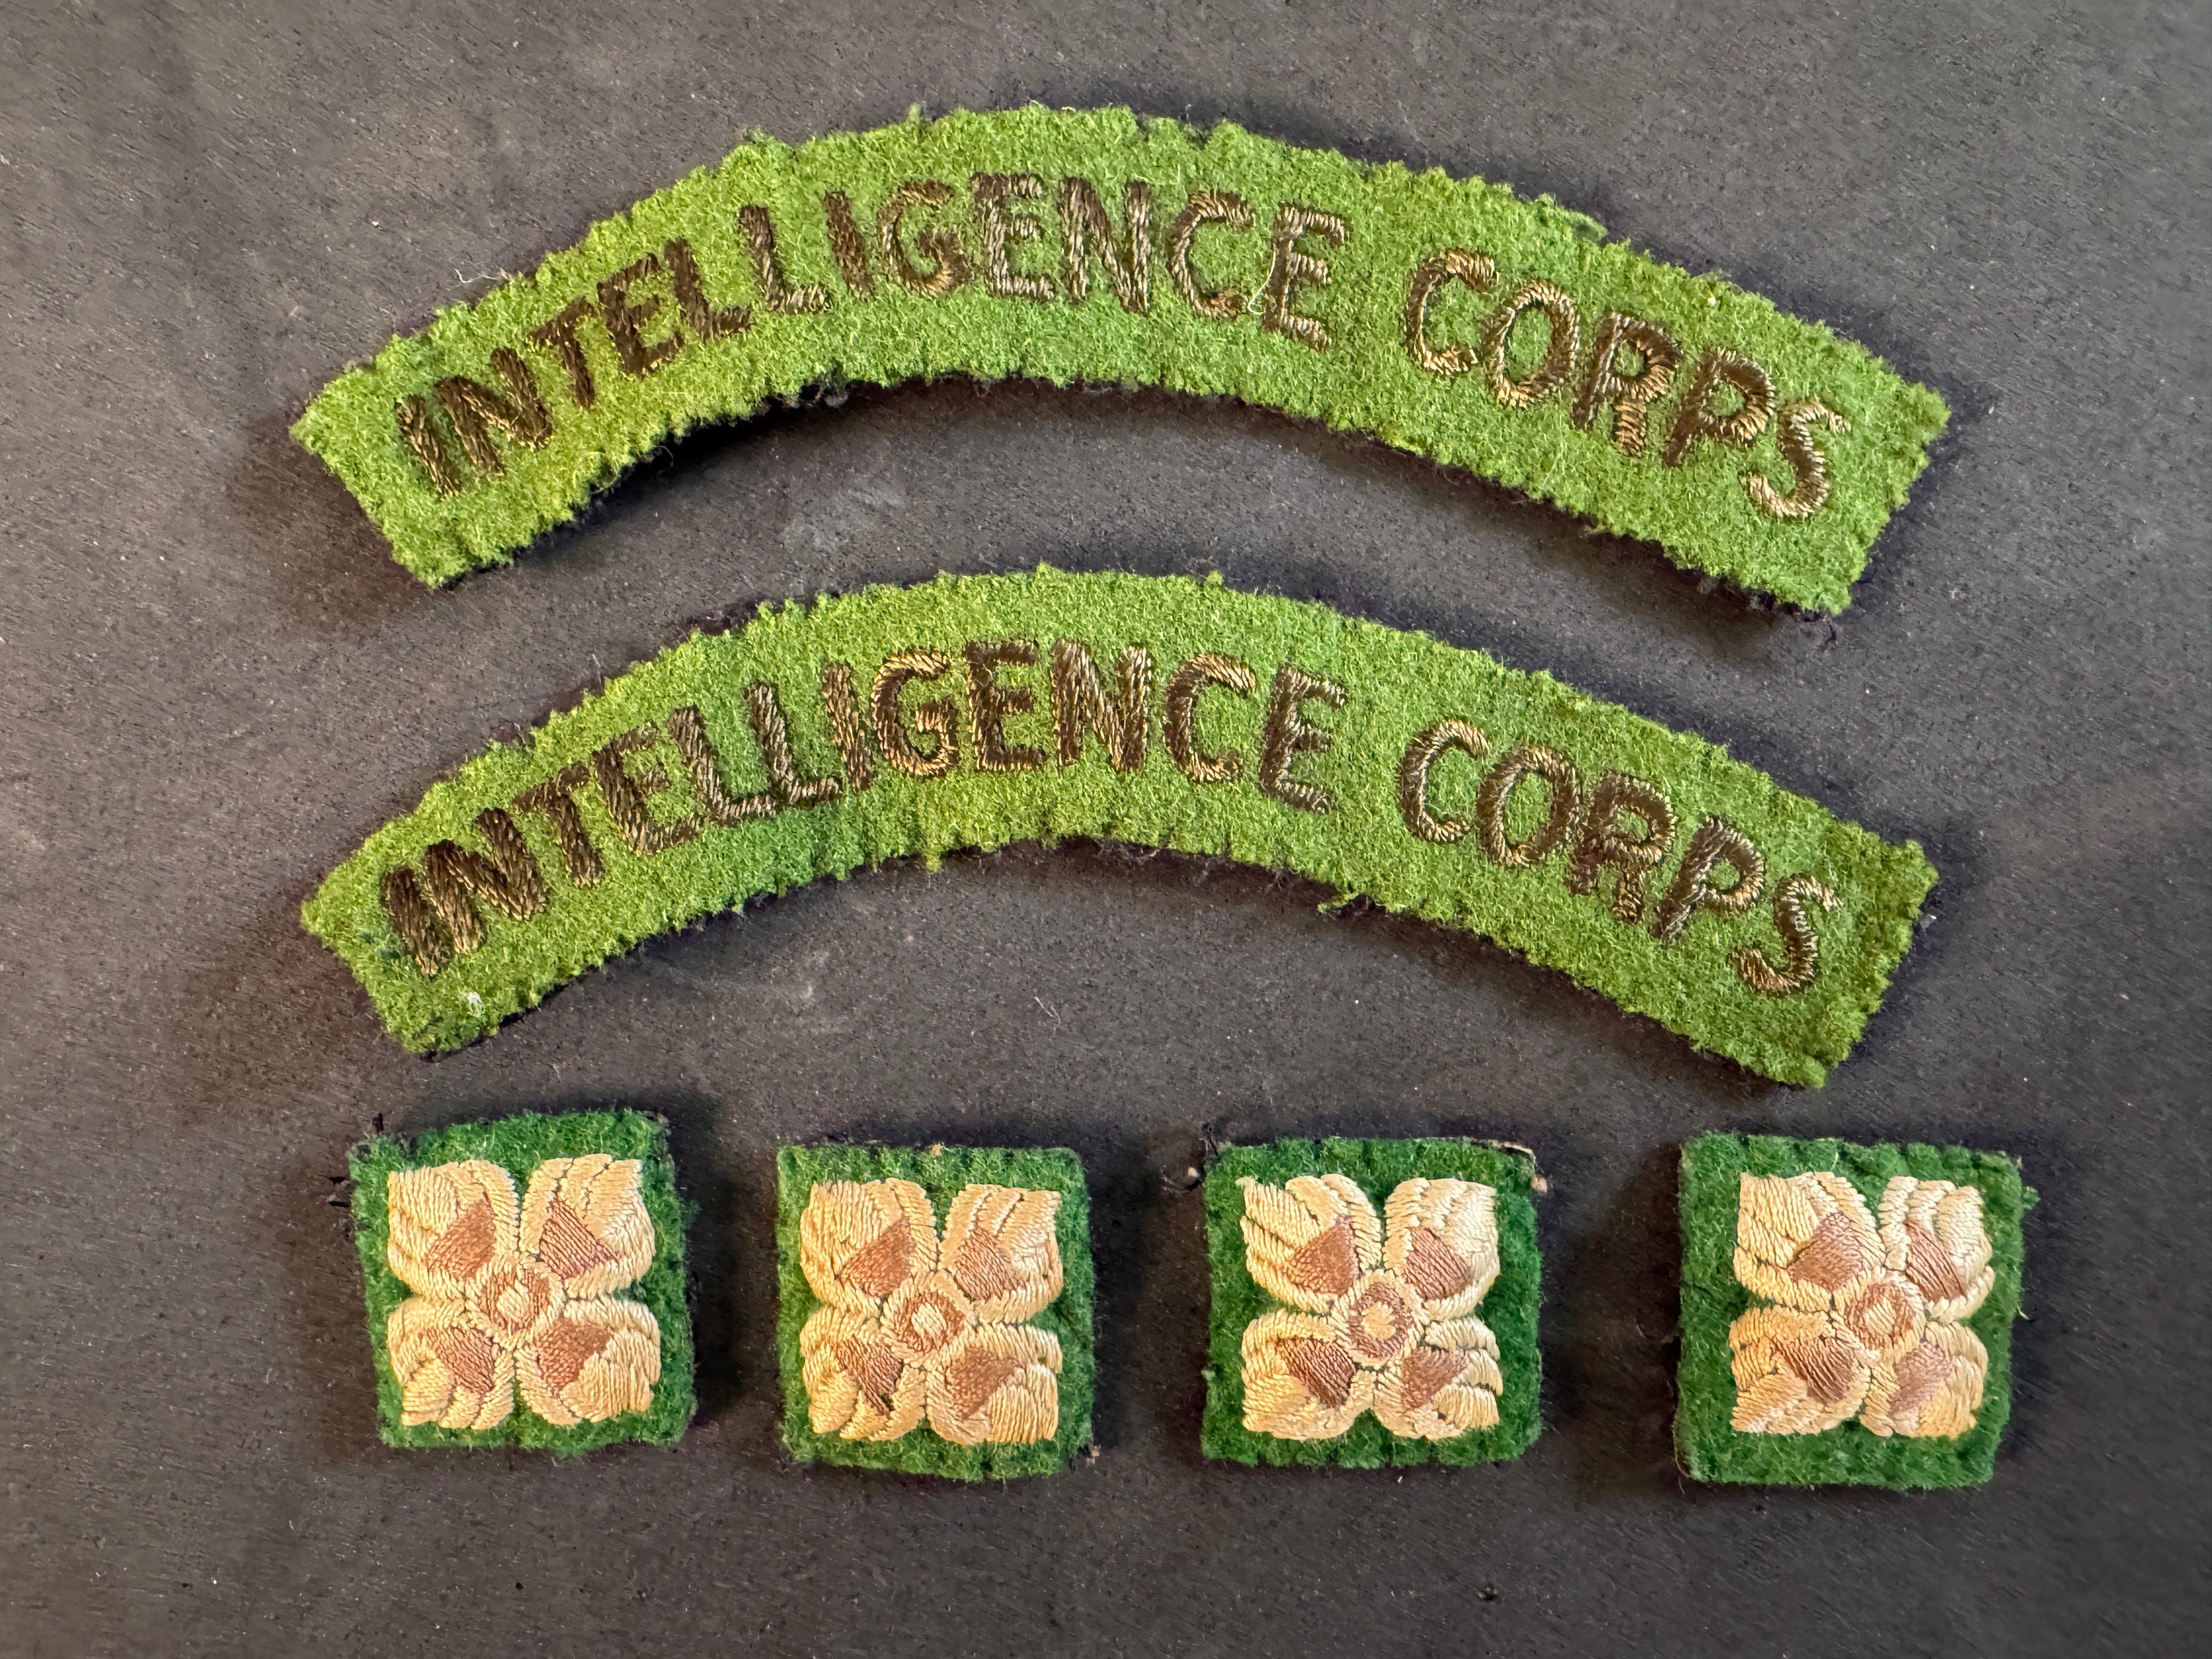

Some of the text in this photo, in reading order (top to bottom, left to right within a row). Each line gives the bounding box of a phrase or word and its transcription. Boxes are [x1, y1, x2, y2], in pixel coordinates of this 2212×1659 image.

[395, 171, 1853, 519] INTELLIGENCE CORPS
[383, 639, 1841, 997] INTELLIGENCE CORPS
